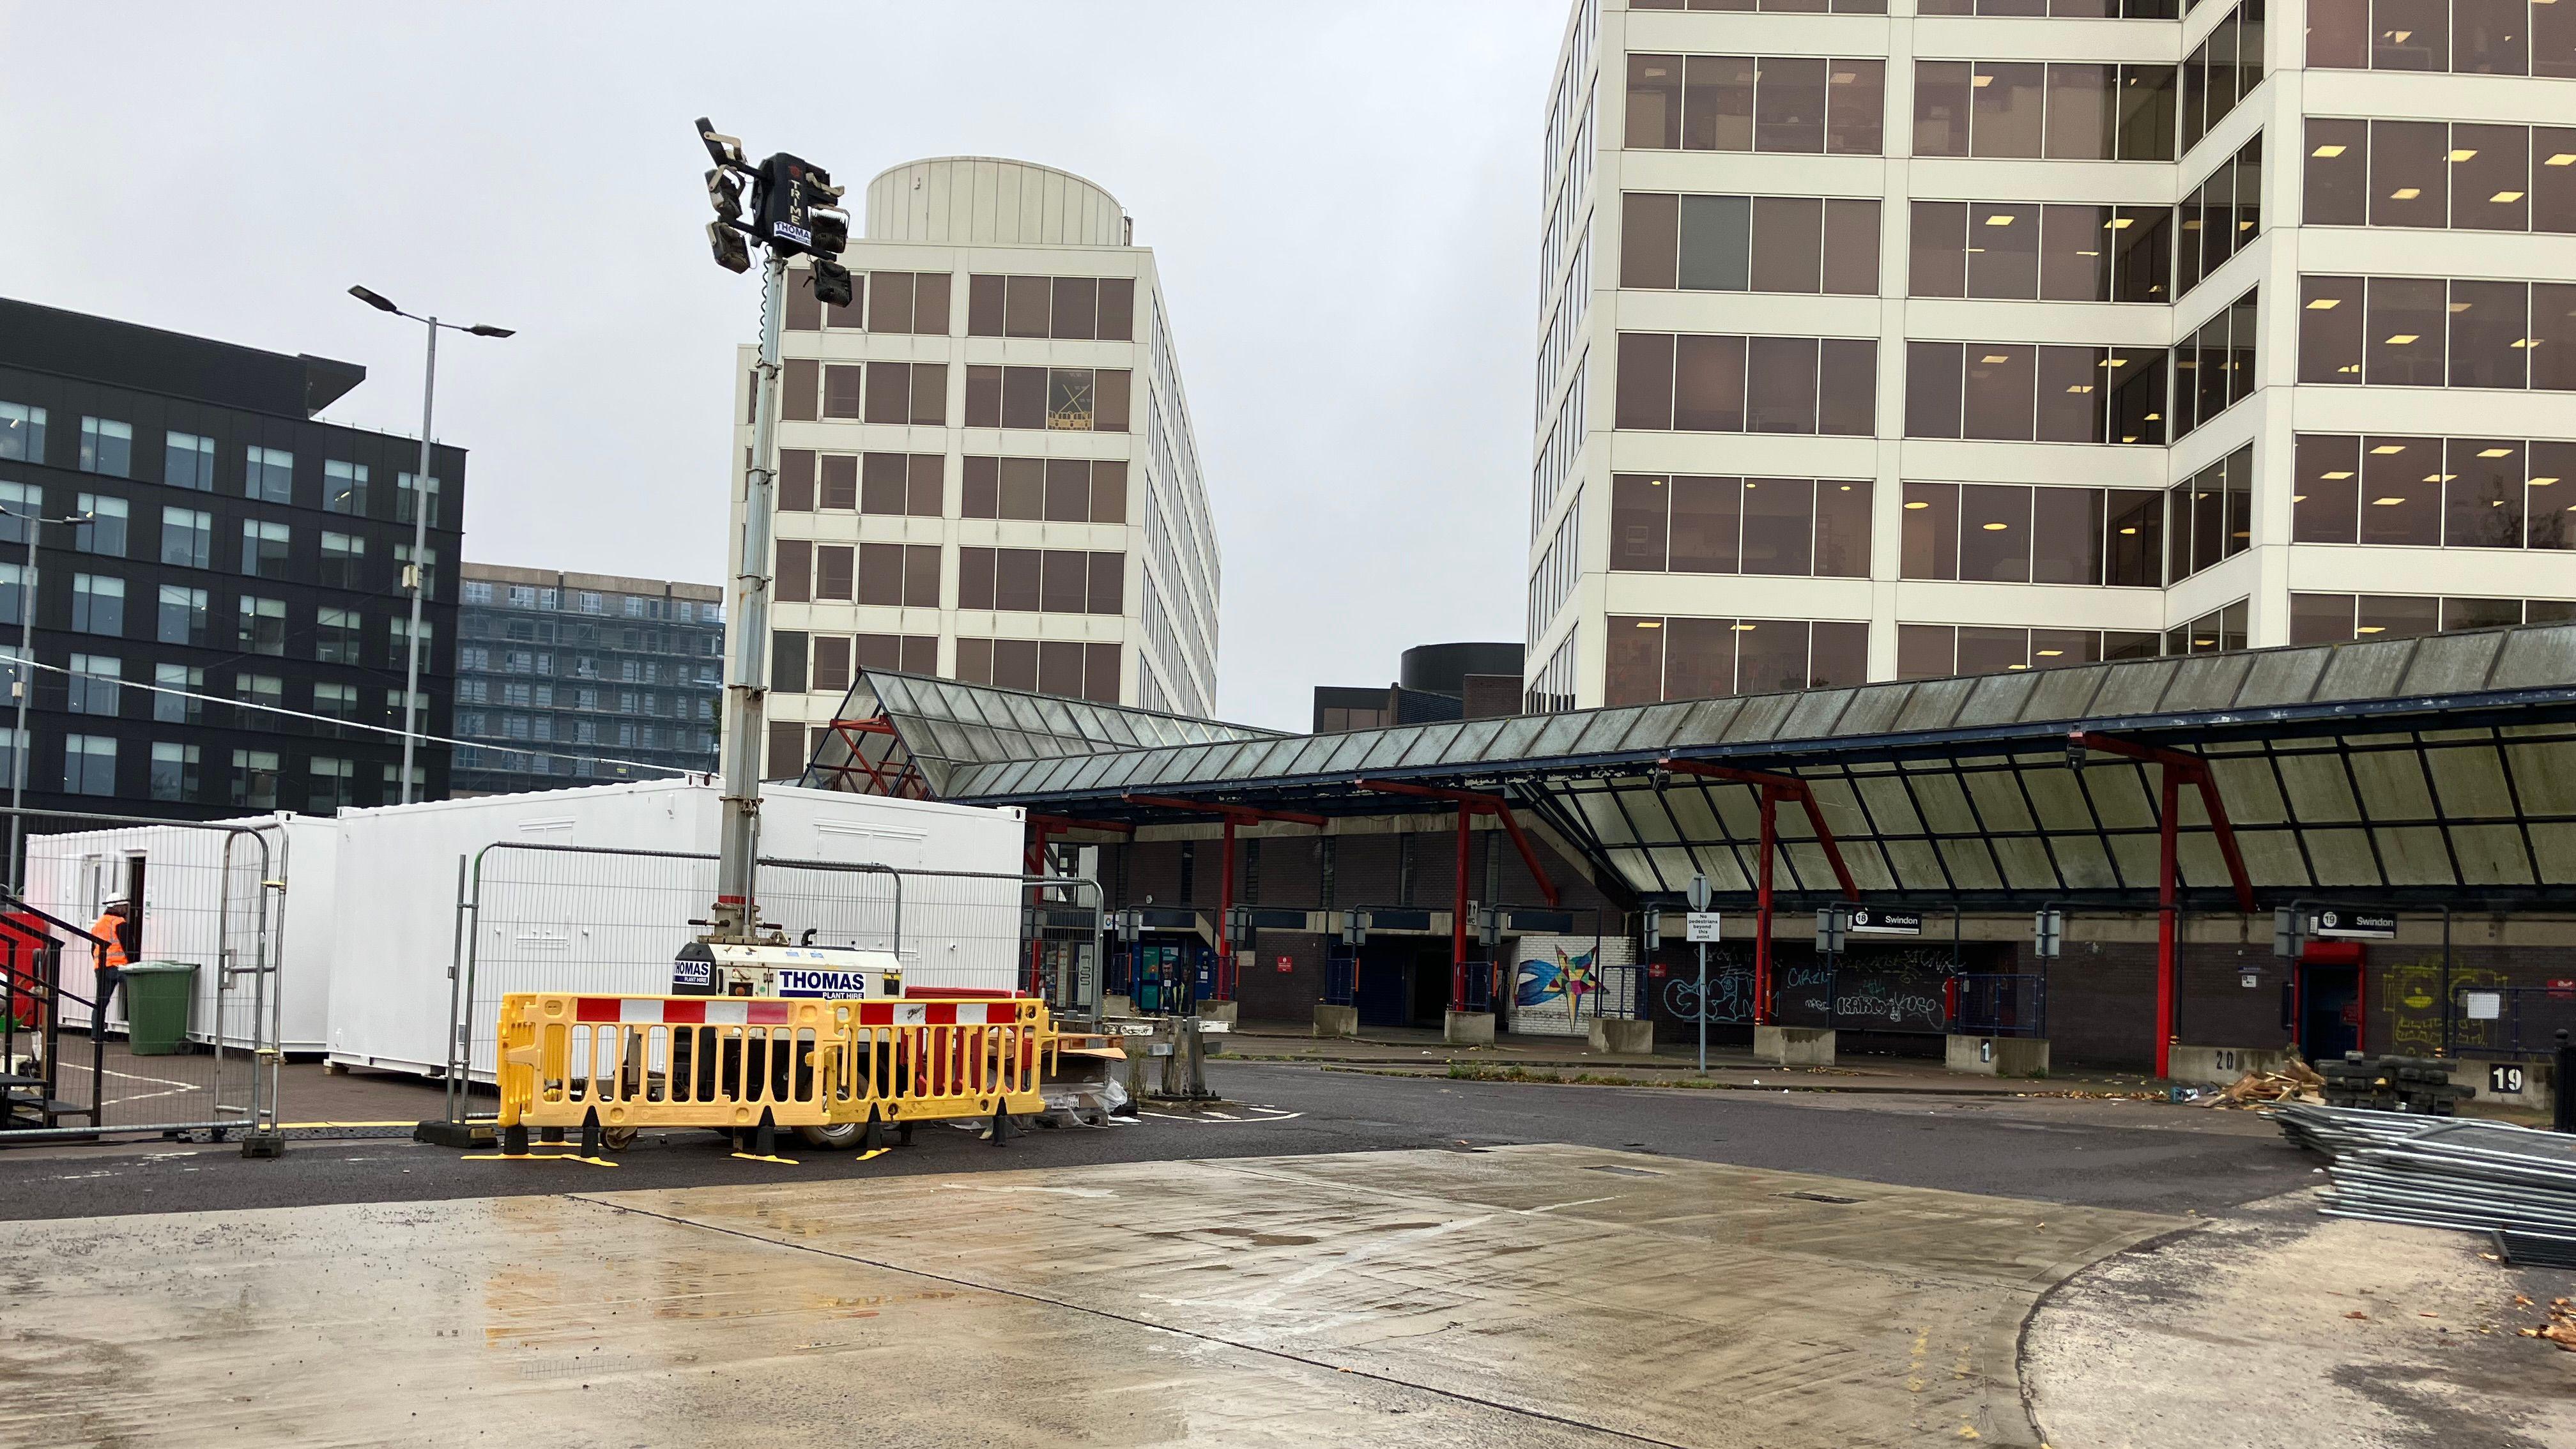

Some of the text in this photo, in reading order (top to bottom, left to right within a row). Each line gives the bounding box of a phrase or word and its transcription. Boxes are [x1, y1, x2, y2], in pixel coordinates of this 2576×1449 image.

[790, 180, 801, 225] TRIME
[776, 222, 810, 238] THOMA
[1885, 915, 1918, 924] Swindon
[2325, 916, 2394, 926] 19 Swindon
[779, 971, 864, 990] THOMAS
[2216, 1051, 2233, 1070] 20
[2493, 1067, 2522, 1090] 19
